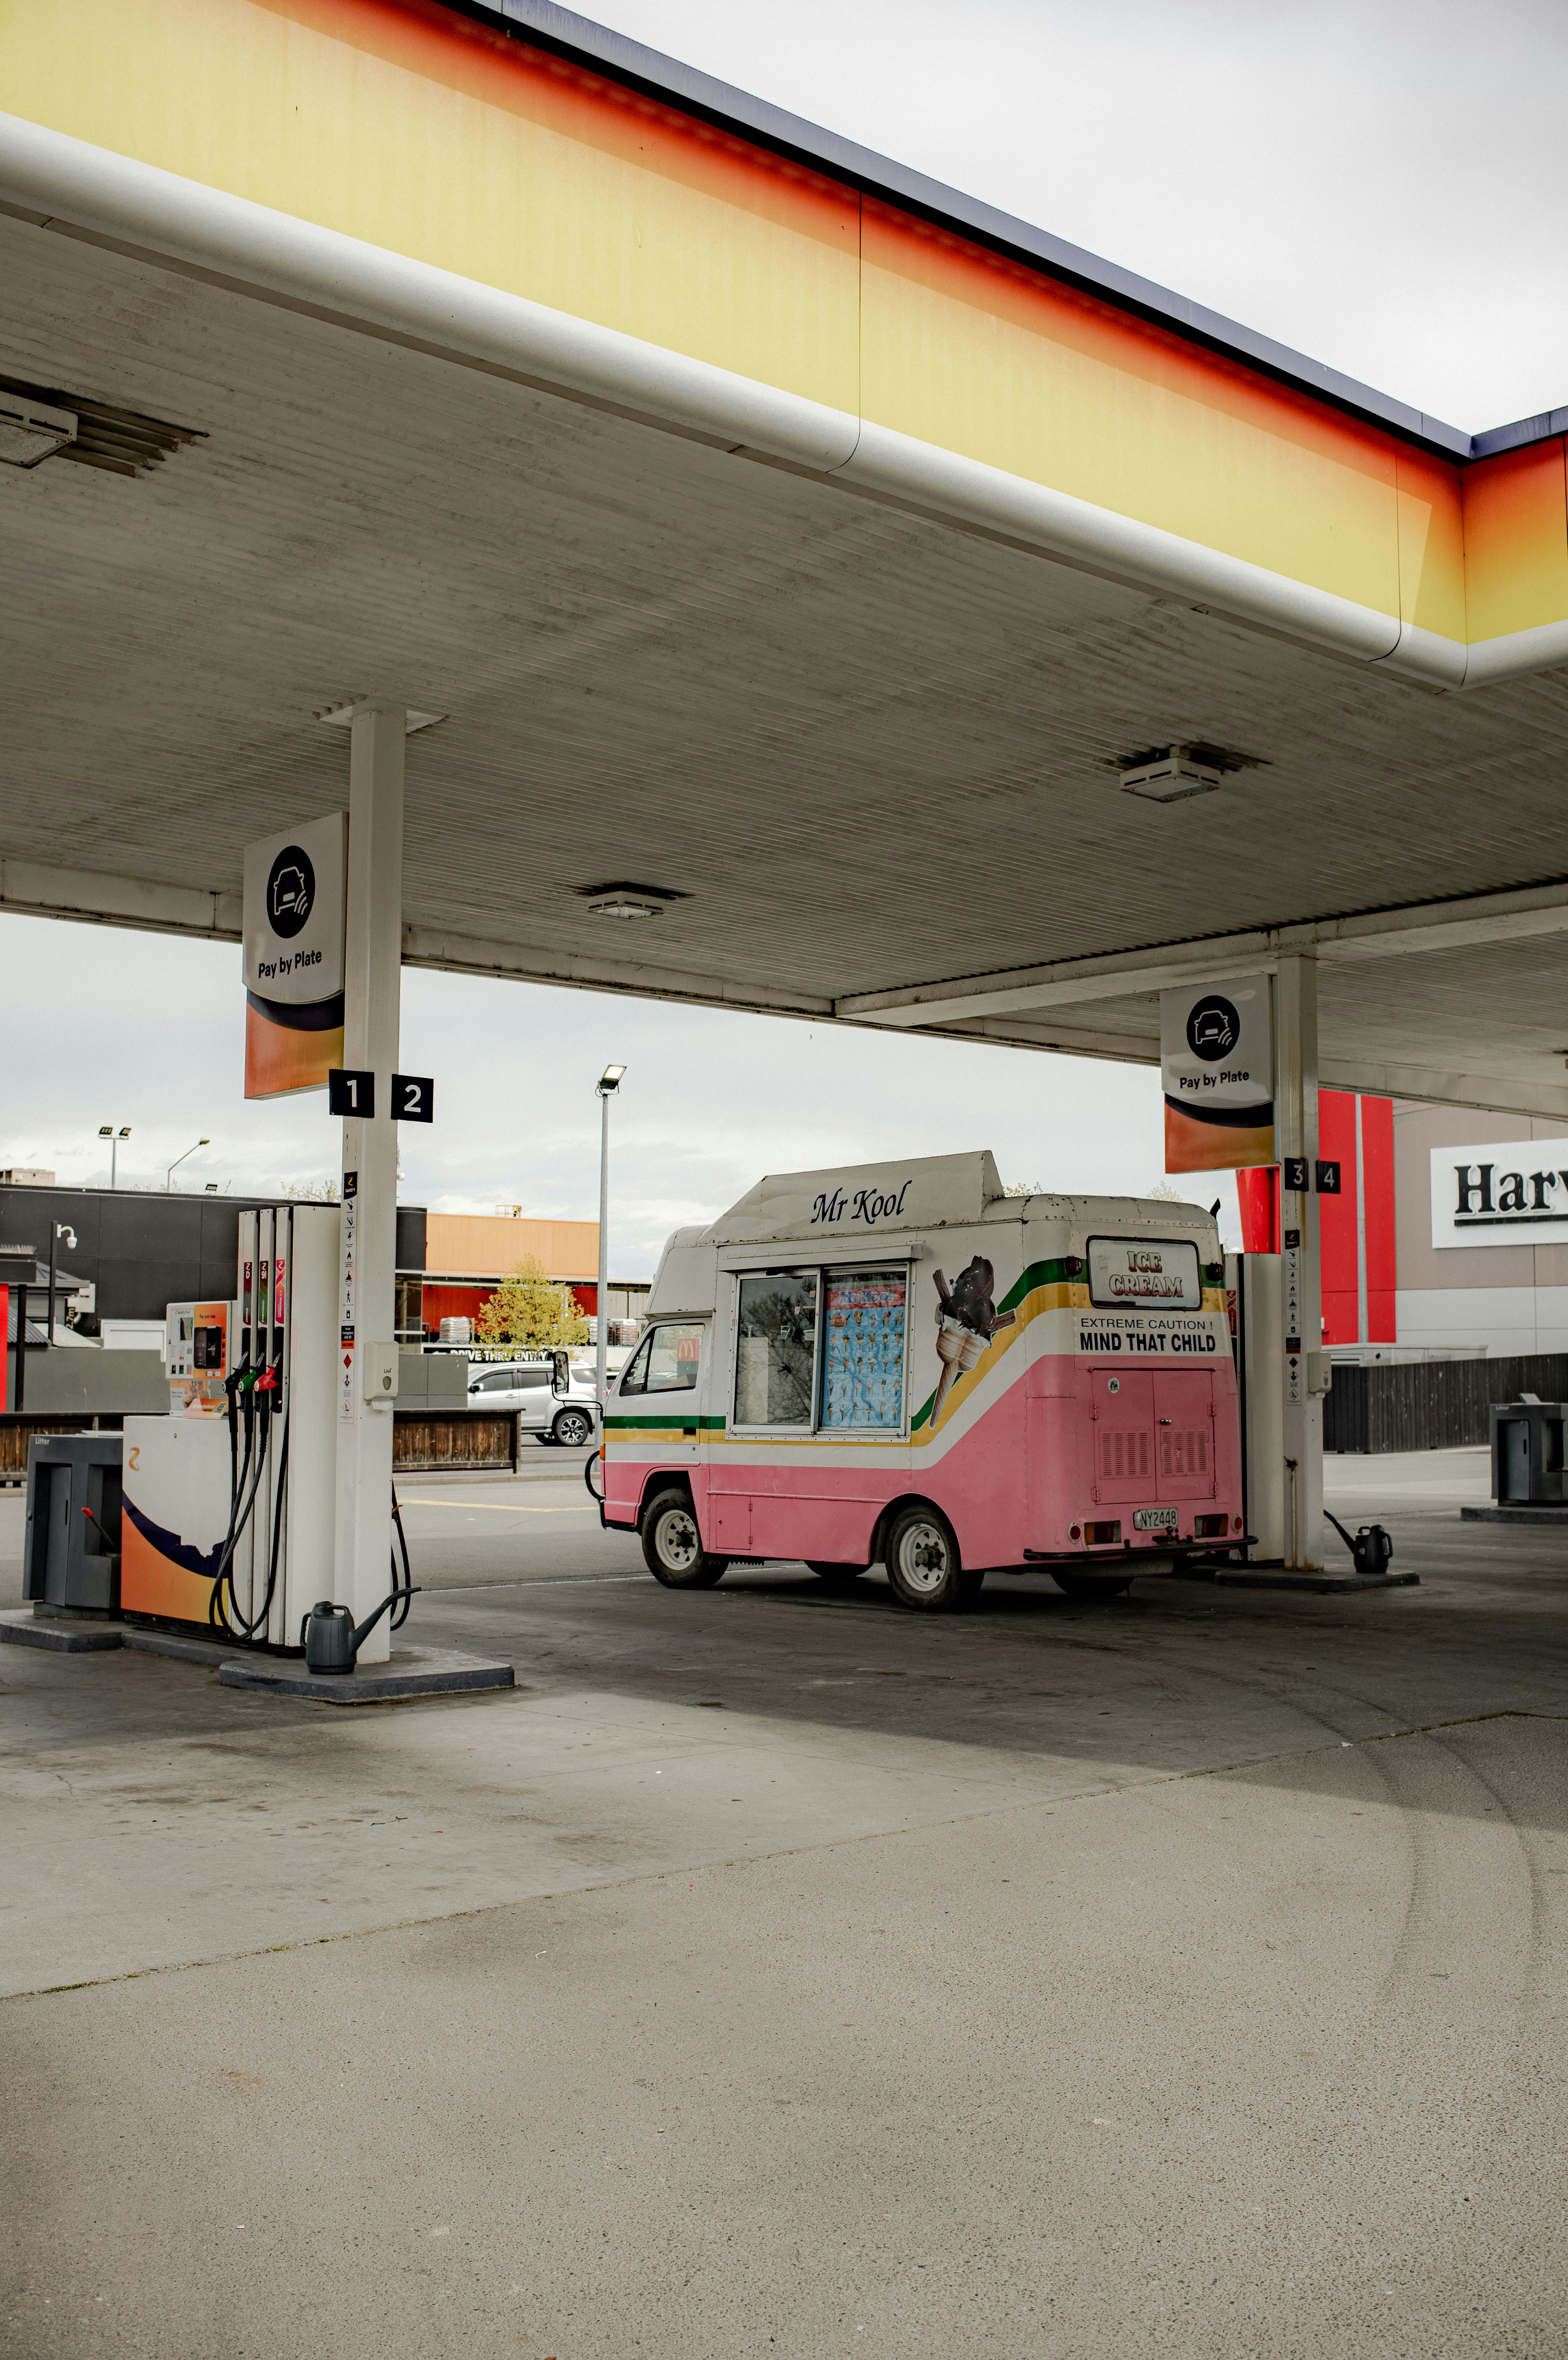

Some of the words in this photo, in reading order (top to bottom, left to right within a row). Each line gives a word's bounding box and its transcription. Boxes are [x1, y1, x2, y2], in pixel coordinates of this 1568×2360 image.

[258, 963, 277, 979] Pay
[280, 957, 292, 975] by
[295, 950, 322, 969] Plate
[1180, 1077, 1200, 1090] Pay
[1203, 1074, 1217, 1087] by
[1220, 1071, 1249, 1083] Plate
[347, 1080, 357, 1107] 1
[404, 1084, 421, 1112] 2
[1293, 1164, 1303, 1184] 3
[1324, 1168, 1335, 1187] 4
[811, 1187, 848, 1223] Mr
[851, 1180, 912, 1224] Kool
[1127, 1251, 1162, 1273] ICE
[261, 1271, 267, 1279] 91
[1109, 1274, 1183, 1297] CREAM
[838, 1290, 860, 1304] Mr
[860, 1287, 894, 1304] Kool
[66, 1308, 75, 1329] 2.7m
[1081, 1318, 1144, 1328] EXTREME
[1148, 1320, 1205, 1329] CAUTION
[1080, 1333, 1122, 1350] MIND
[1126, 1333, 1166, 1351] THAT
[1171, 1334, 1216, 1351] CHILD
[514, 1350, 548, 1361] ENTRY
[1141, 1511, 1176, 1527] NY2448
